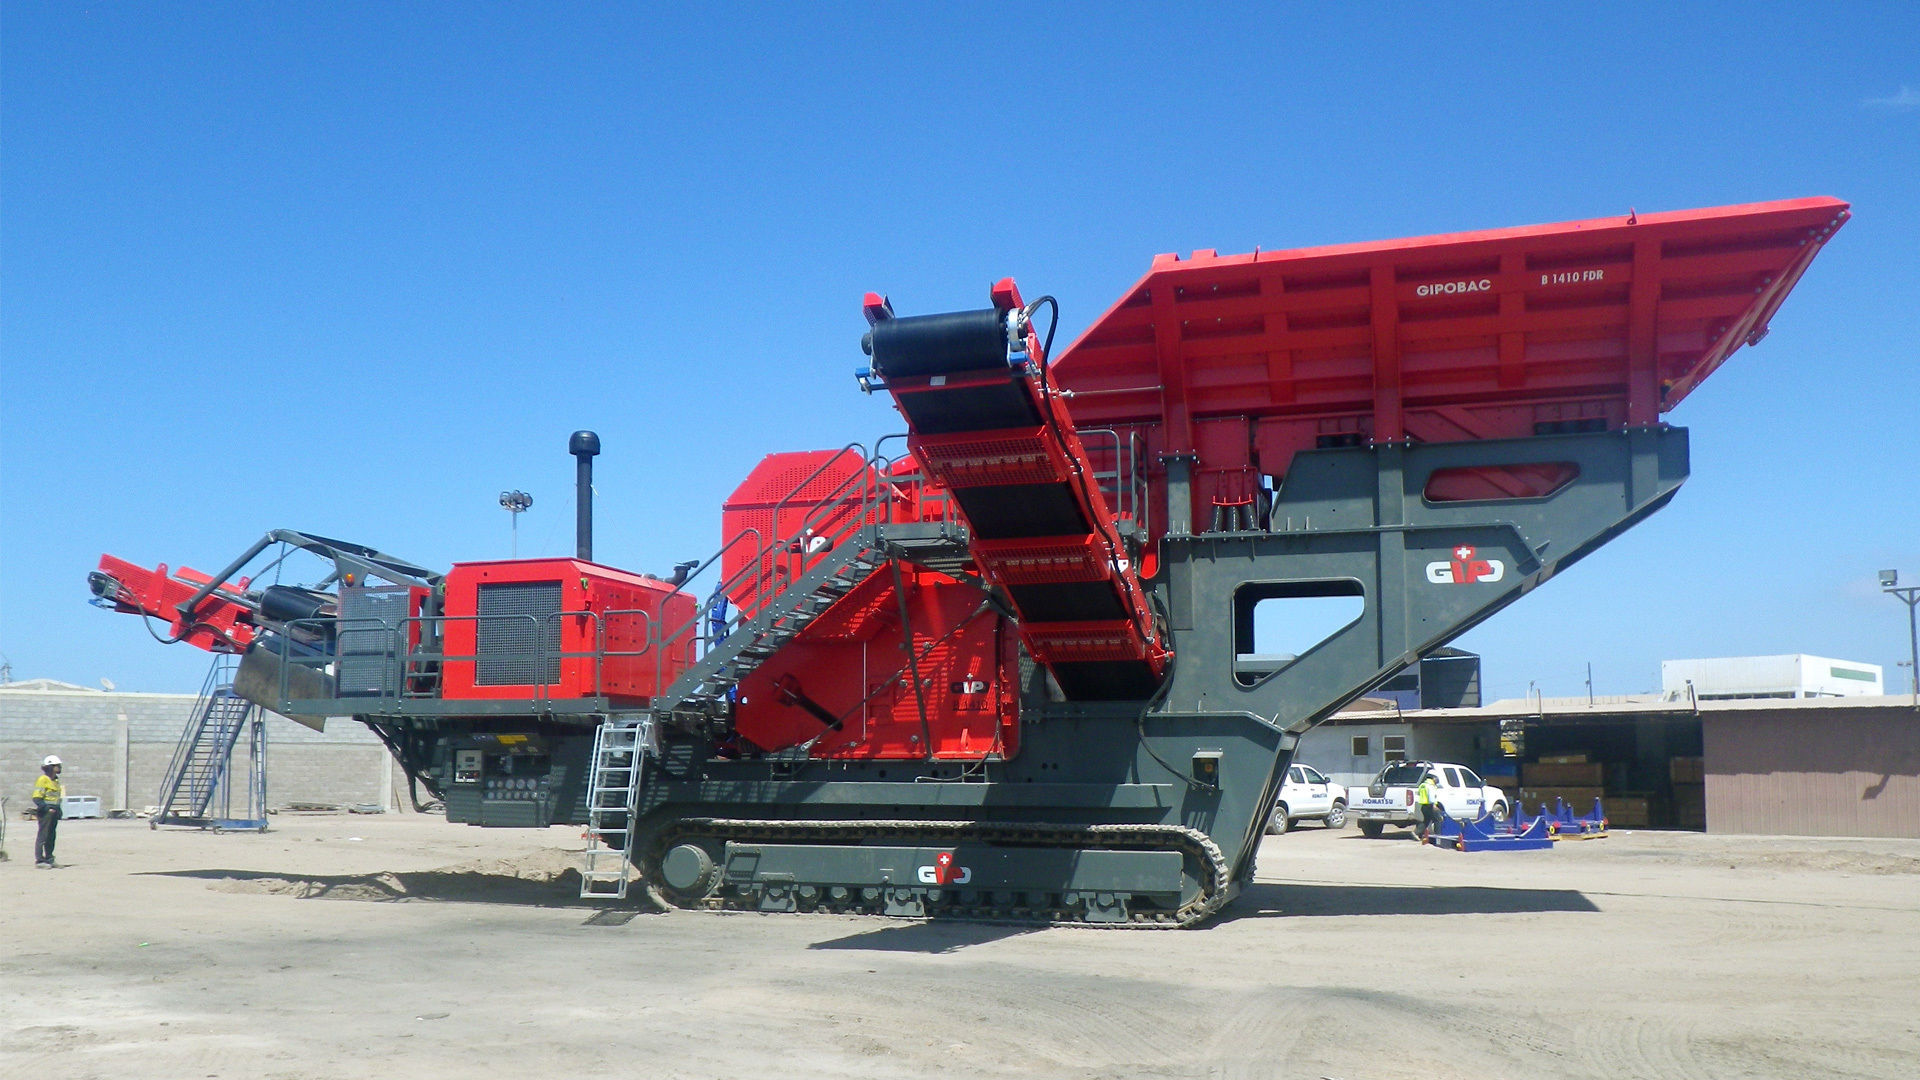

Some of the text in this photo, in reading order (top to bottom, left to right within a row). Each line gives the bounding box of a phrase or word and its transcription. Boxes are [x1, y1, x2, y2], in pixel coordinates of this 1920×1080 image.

[1541, 269, 1604, 285] B 1410 FDR
[1416, 279, 1491, 297] GIPOBAC
[1362, 797, 1394, 805] KOMATSU
